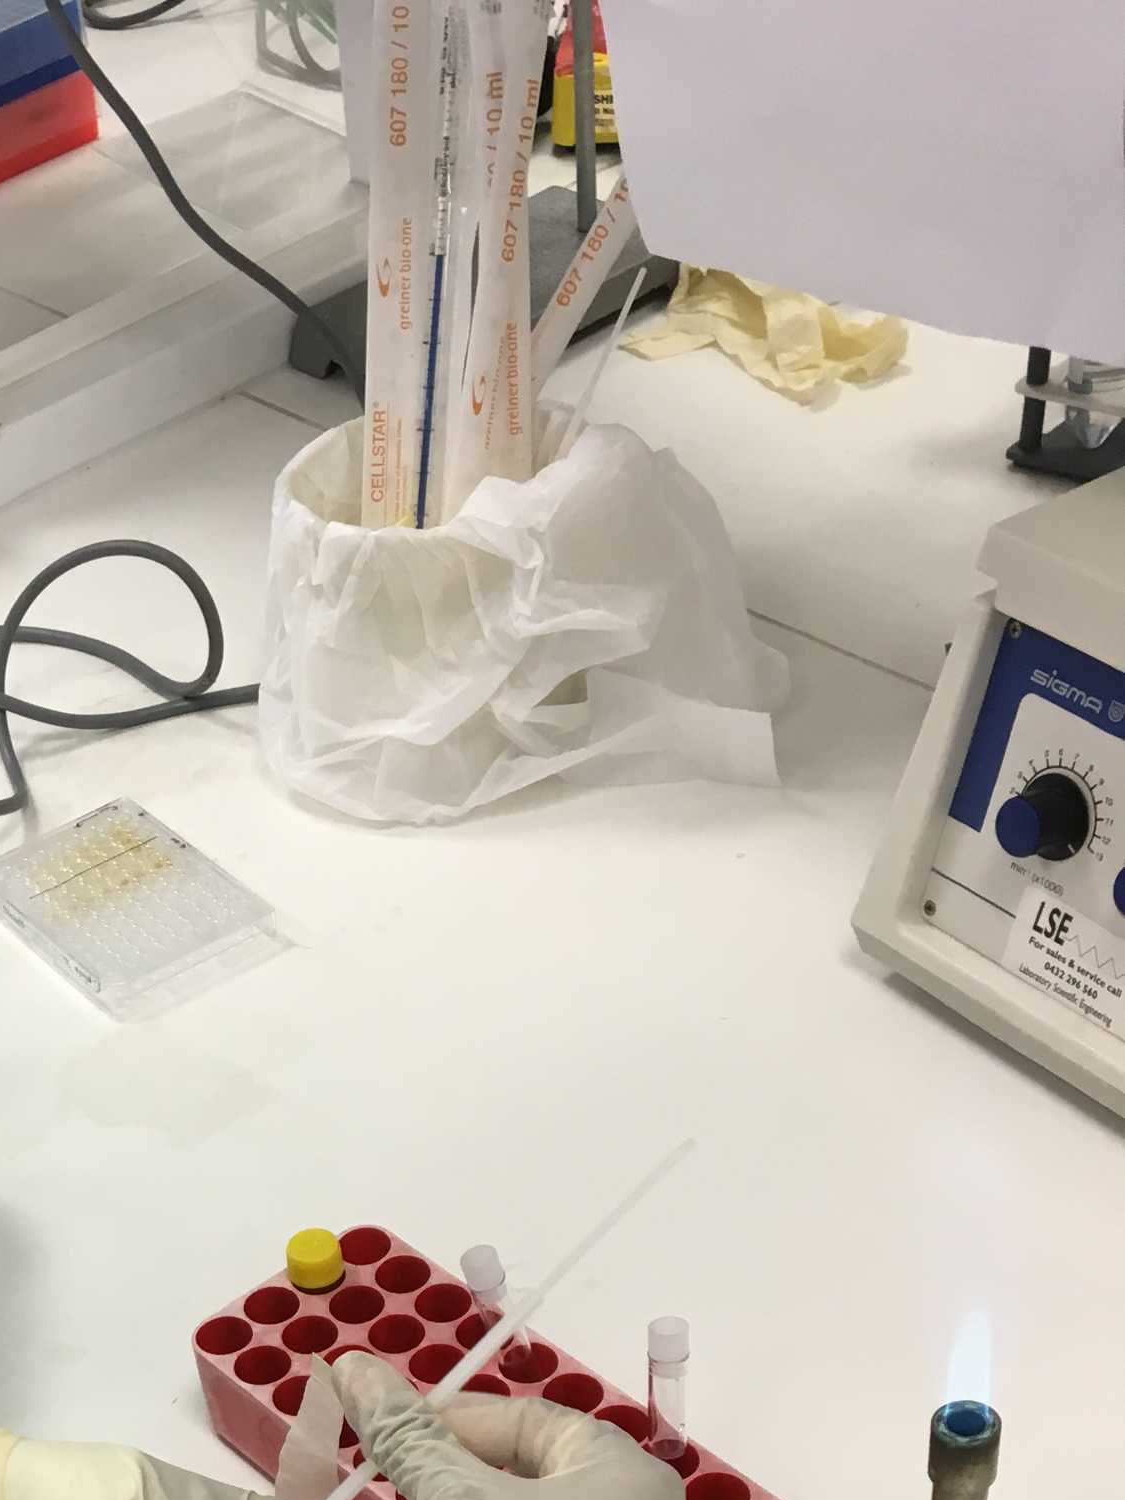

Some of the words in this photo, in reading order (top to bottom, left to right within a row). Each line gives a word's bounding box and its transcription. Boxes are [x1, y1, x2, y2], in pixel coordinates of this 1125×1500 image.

[391, 6, 410, 33] 10
[390, 57, 409, 97] 180
[486, 72, 503, 100] ml
[526, 79, 539, 108] ml
[389, 107, 407, 147] 607
[486, 109, 503, 136] 10
[518, 117, 534, 143] 10
[509, 170, 525, 211] 180
[501, 220, 518, 262] 607
[556, 267, 583, 307] 607
[580, 224, 609, 261] 180
[399, 273, 412, 330] greiner
[507, 384, 522, 436] greiner
[1032, 901, 1074, 946] LSE
[1029, 936, 1045, 951] For
[1046, 947, 1067, 964] sales
[1068, 959, 1075, 969] &
[1077, 966, 1106, 988] service
[1106, 984, 1123, 999] call
[1044, 961, 1065, 980] 0432
[1066, 974, 1081, 989] 296
[1082, 984, 1098, 1000] 560
[1018, 962, 1052, 990] Laboratory
[1053, 983, 1078, 1005] Scientific
[1079, 999, 1113, 1028] Engineering
